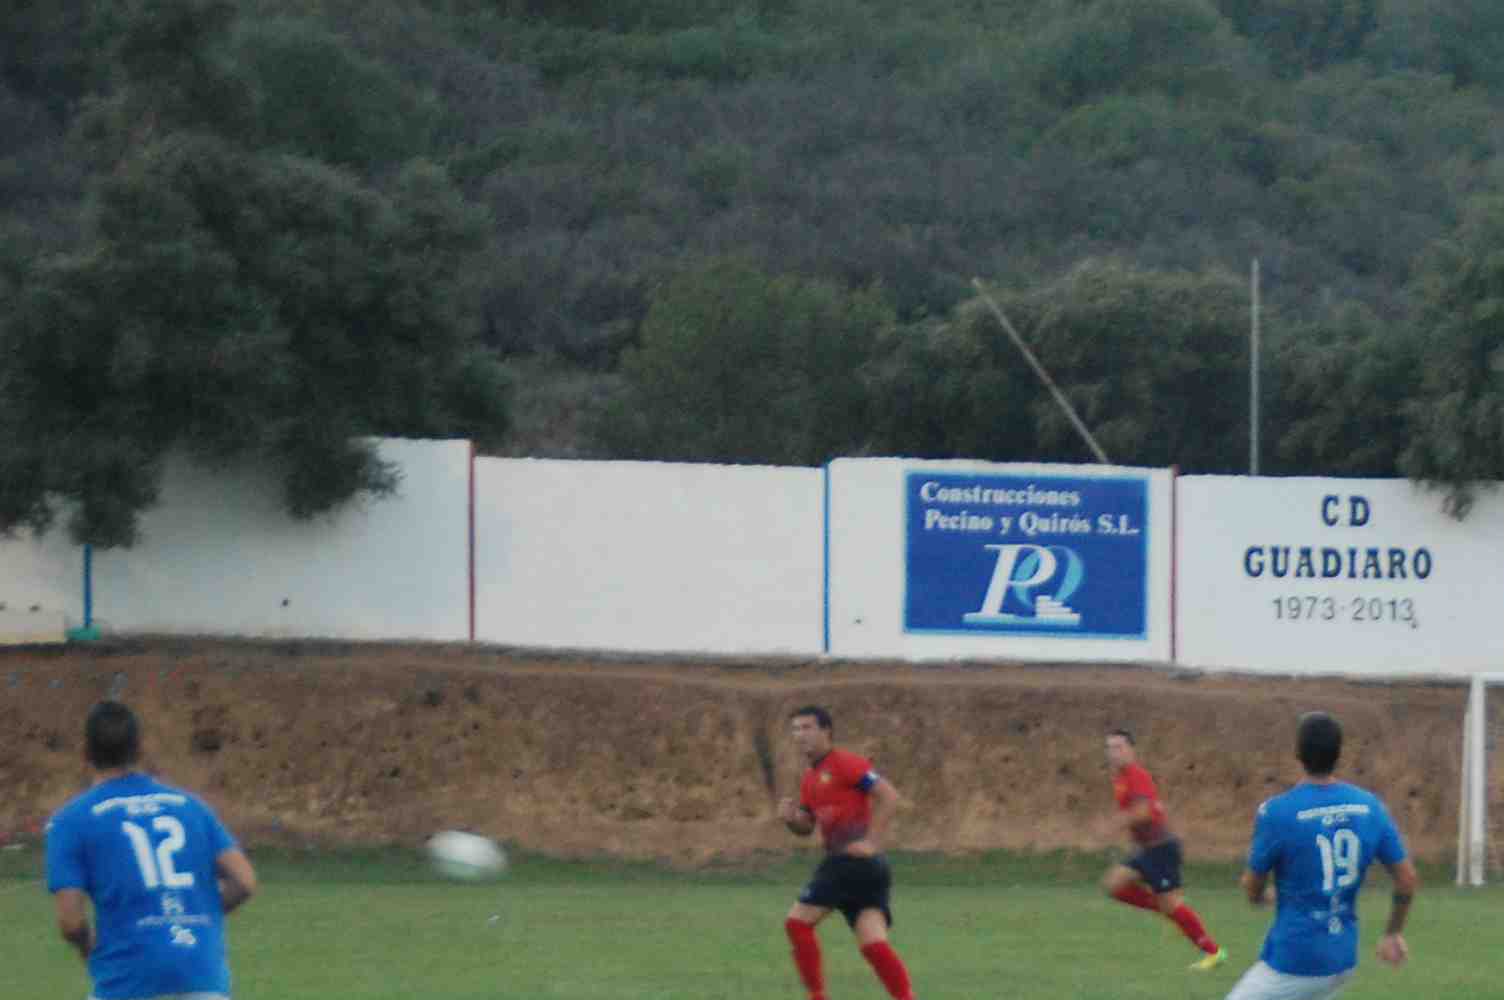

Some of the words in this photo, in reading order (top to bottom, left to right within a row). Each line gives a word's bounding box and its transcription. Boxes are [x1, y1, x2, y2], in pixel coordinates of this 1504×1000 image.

[920, 481, 1081, 506] Construcciones
[924, 508, 993, 531] Pecino
[1000, 518, 1013, 534] y
[1244, 545, 1432, 579] GUADIARO
[121, 815, 194, 888] 12
[1316, 828, 1361, 891] 19
